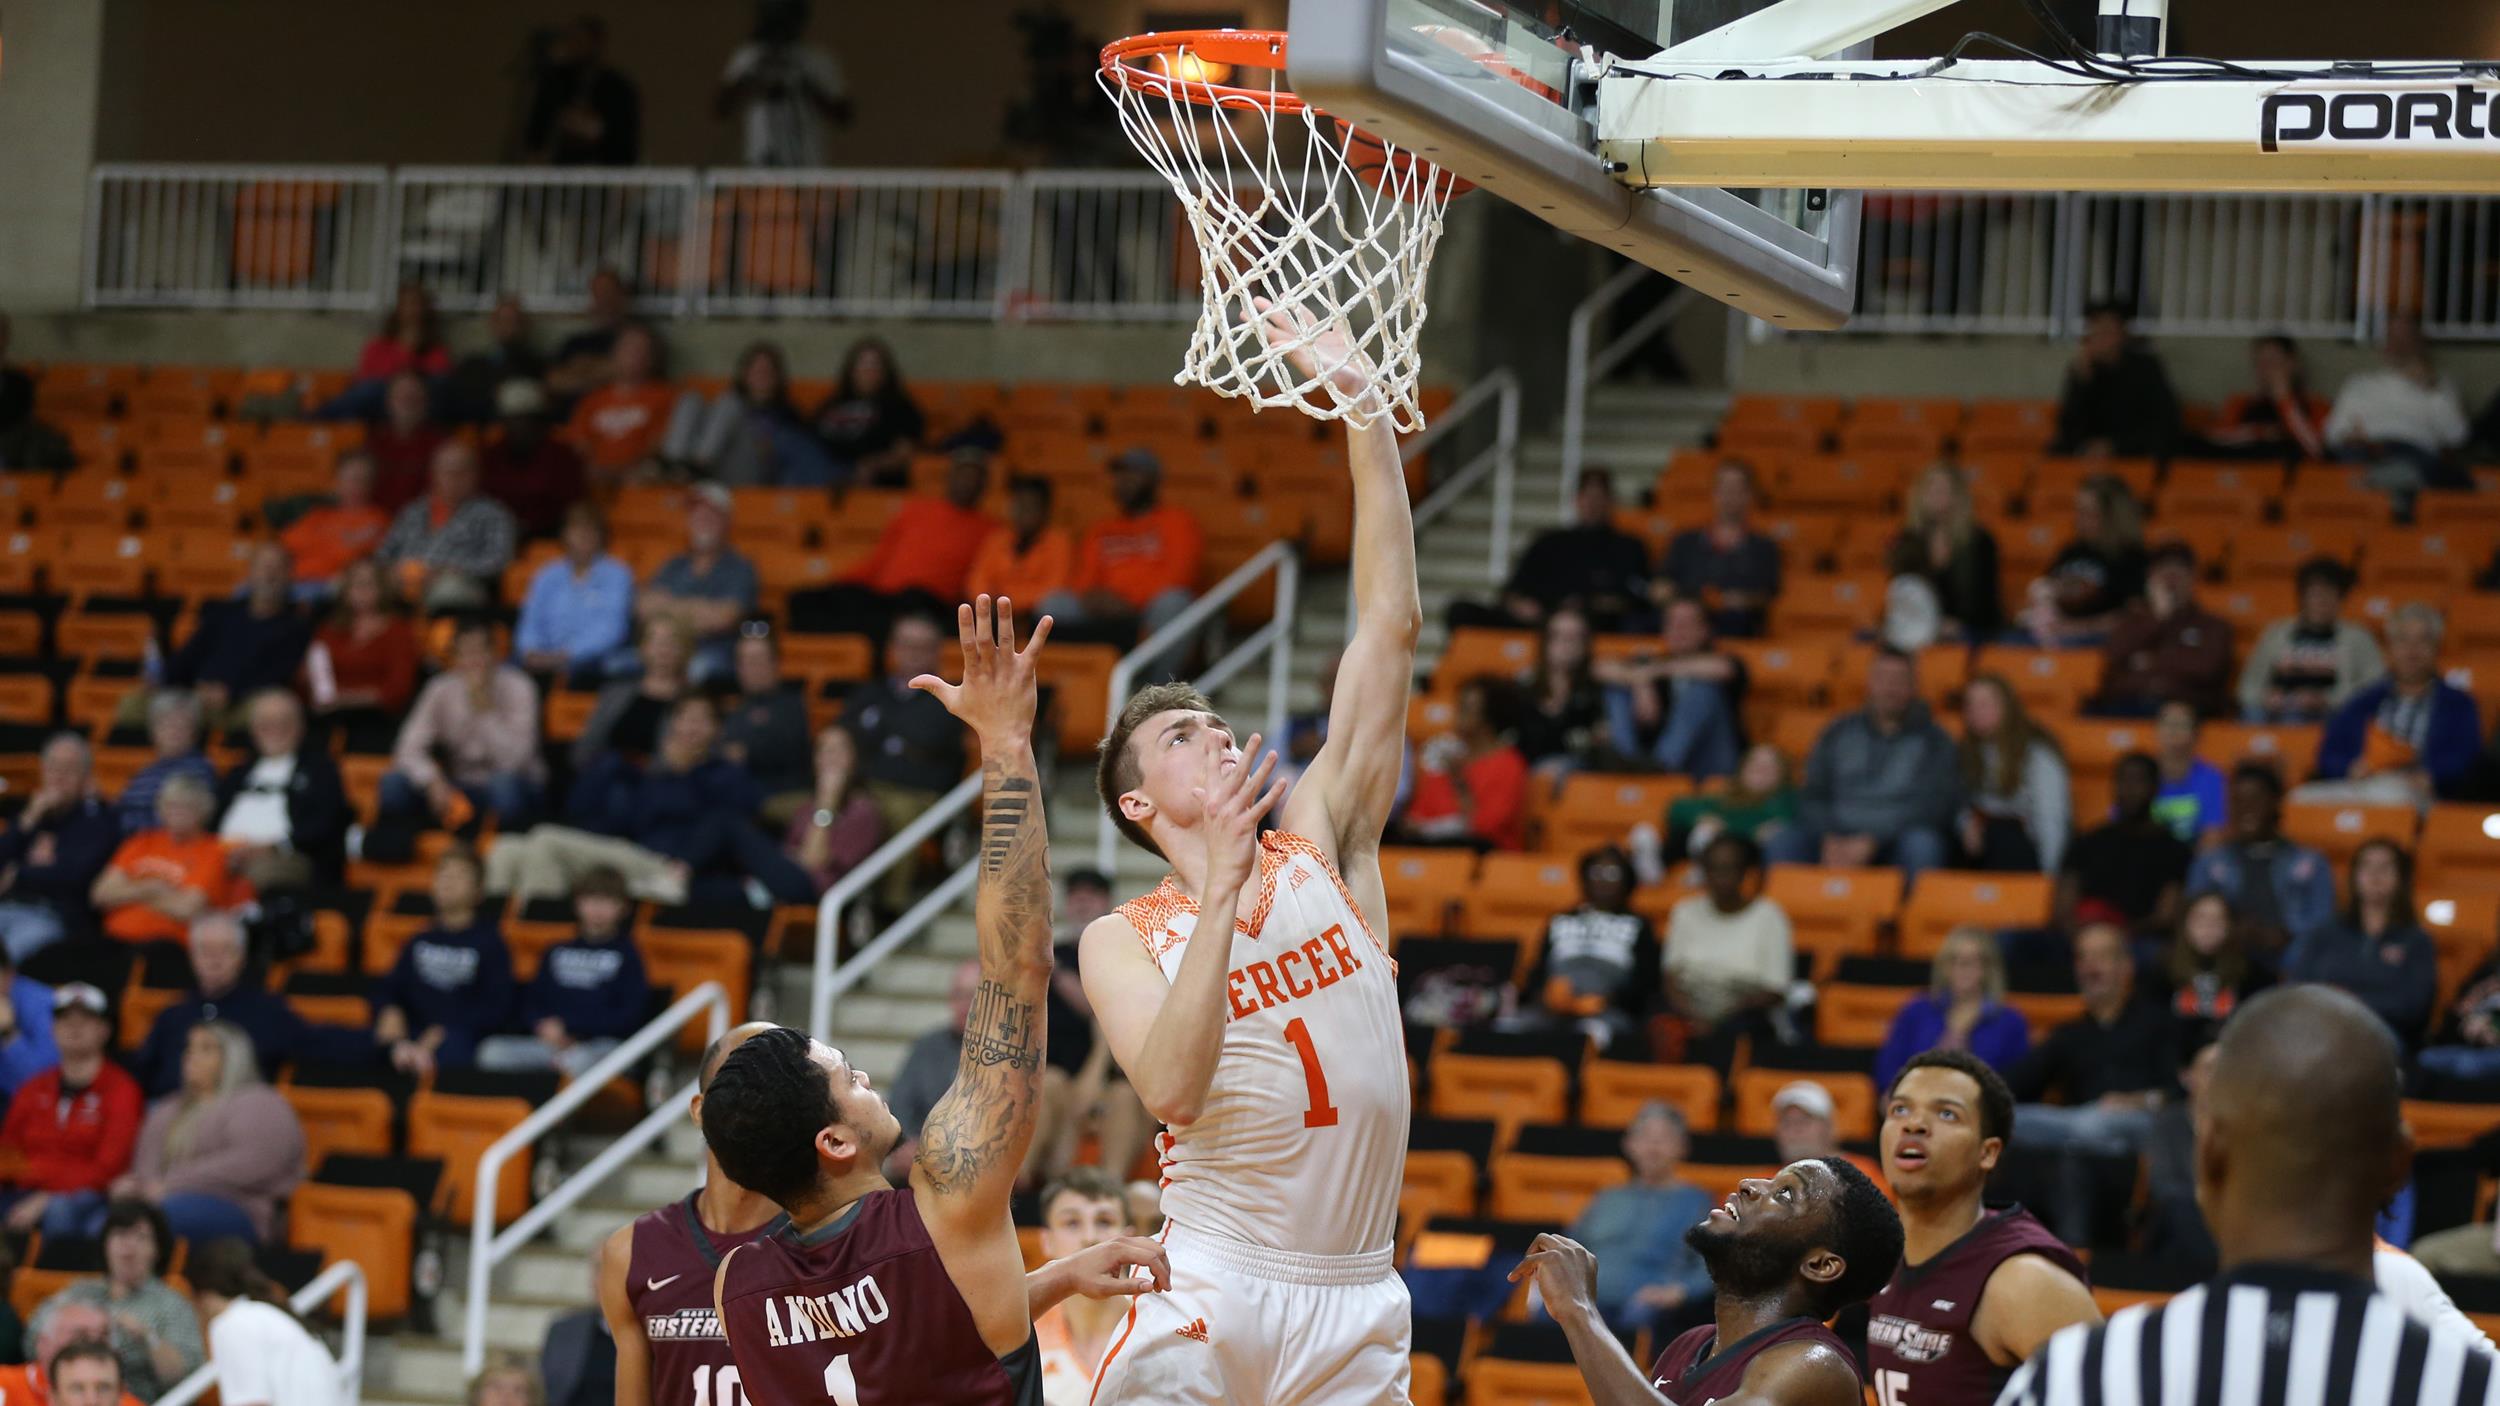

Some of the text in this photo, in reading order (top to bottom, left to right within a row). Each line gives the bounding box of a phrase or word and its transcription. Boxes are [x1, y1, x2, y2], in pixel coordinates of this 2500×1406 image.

[2261, 85, 2500, 152] poRt
[1227, 922, 1363, 1024] ERCER
[1283, 1017, 1338, 1128] 1
[765, 1274, 890, 1347] ANDINO
[1175, 1327, 1209, 1345] adidas
[692, 1364, 752, 1406] 10
[824, 1353, 860, 1406] 1
